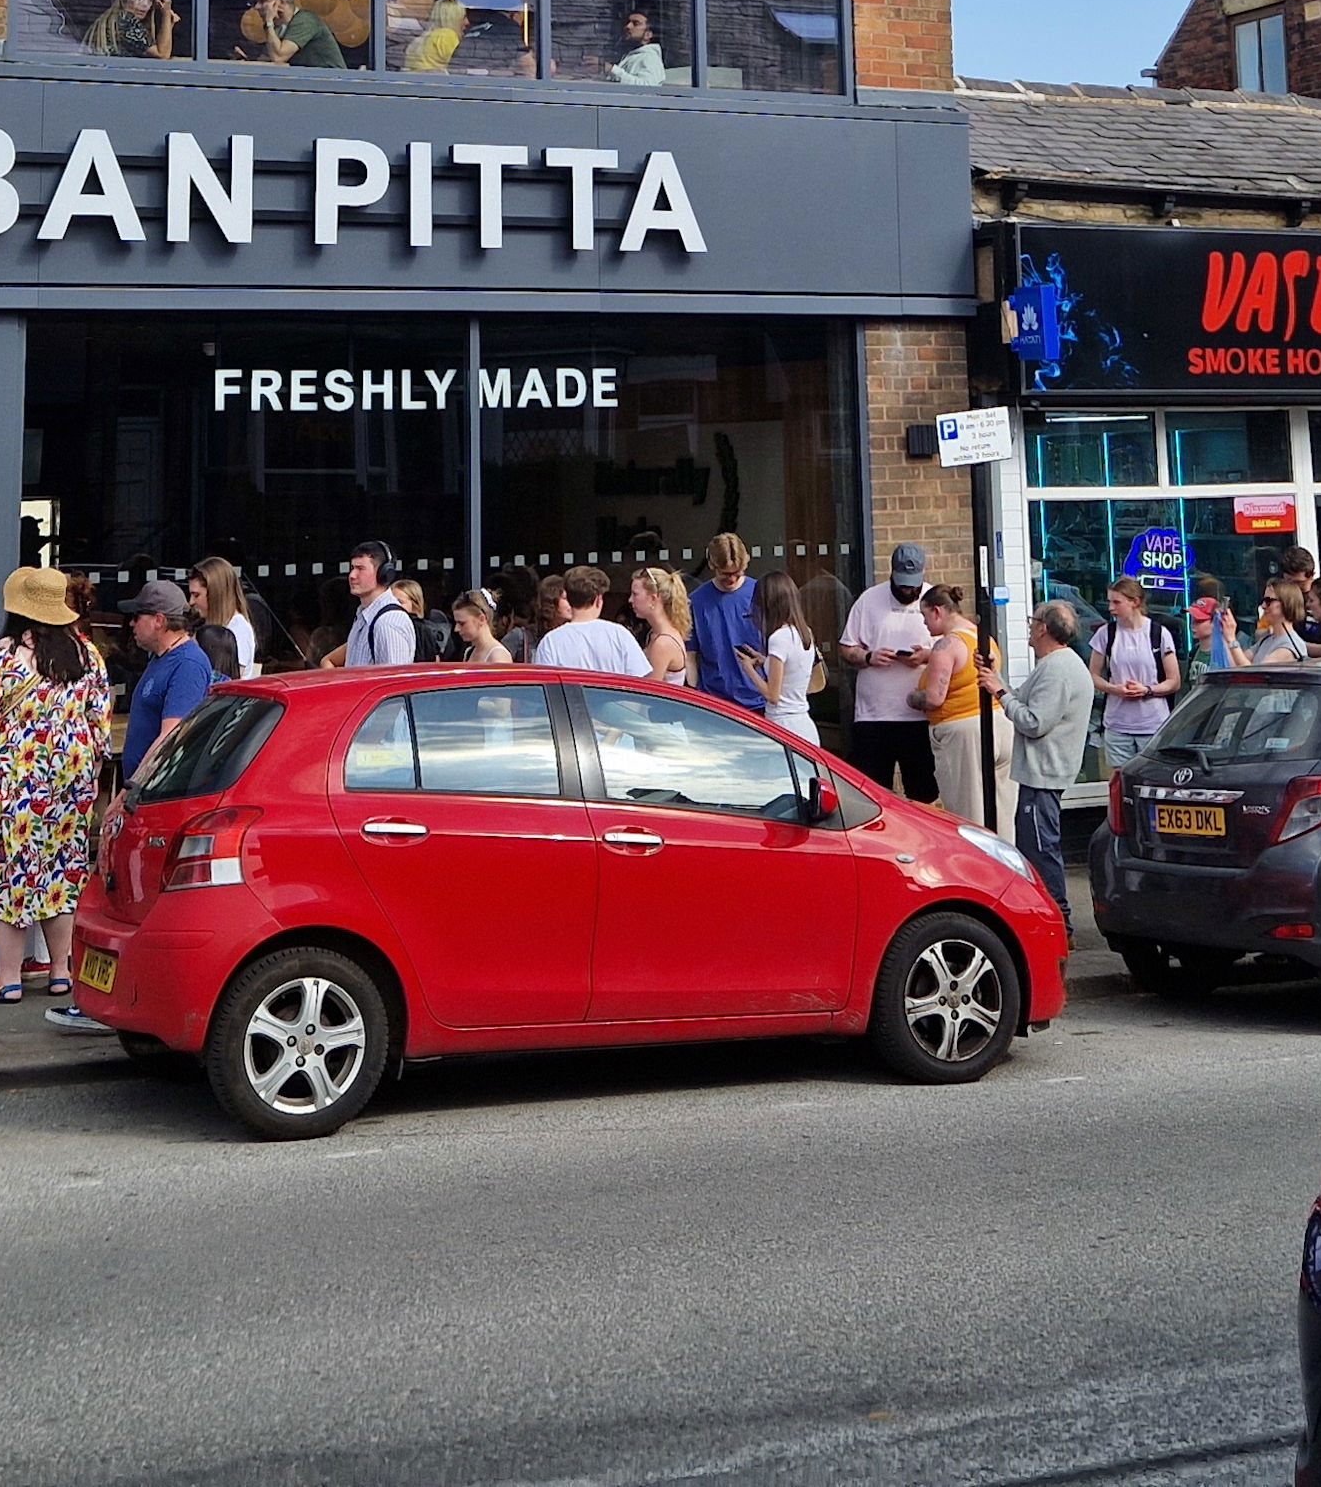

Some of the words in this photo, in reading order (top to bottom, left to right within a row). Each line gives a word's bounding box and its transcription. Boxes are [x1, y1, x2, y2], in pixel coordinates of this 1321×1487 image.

[313, 137, 708, 253] PITTA
[1188, 347, 1282, 376] SMOKE
[214, 368, 457, 412] FRESHLY
[479, 367, 619, 409] MADE
[1242, 501, 1287, 516] Diamond
[1145, 534, 1181, 554] VAPE
[1142, 551, 1183, 570] SHOP
[1157, 808, 1192, 830] EX63
[1196, 811, 1223, 831] DKL
